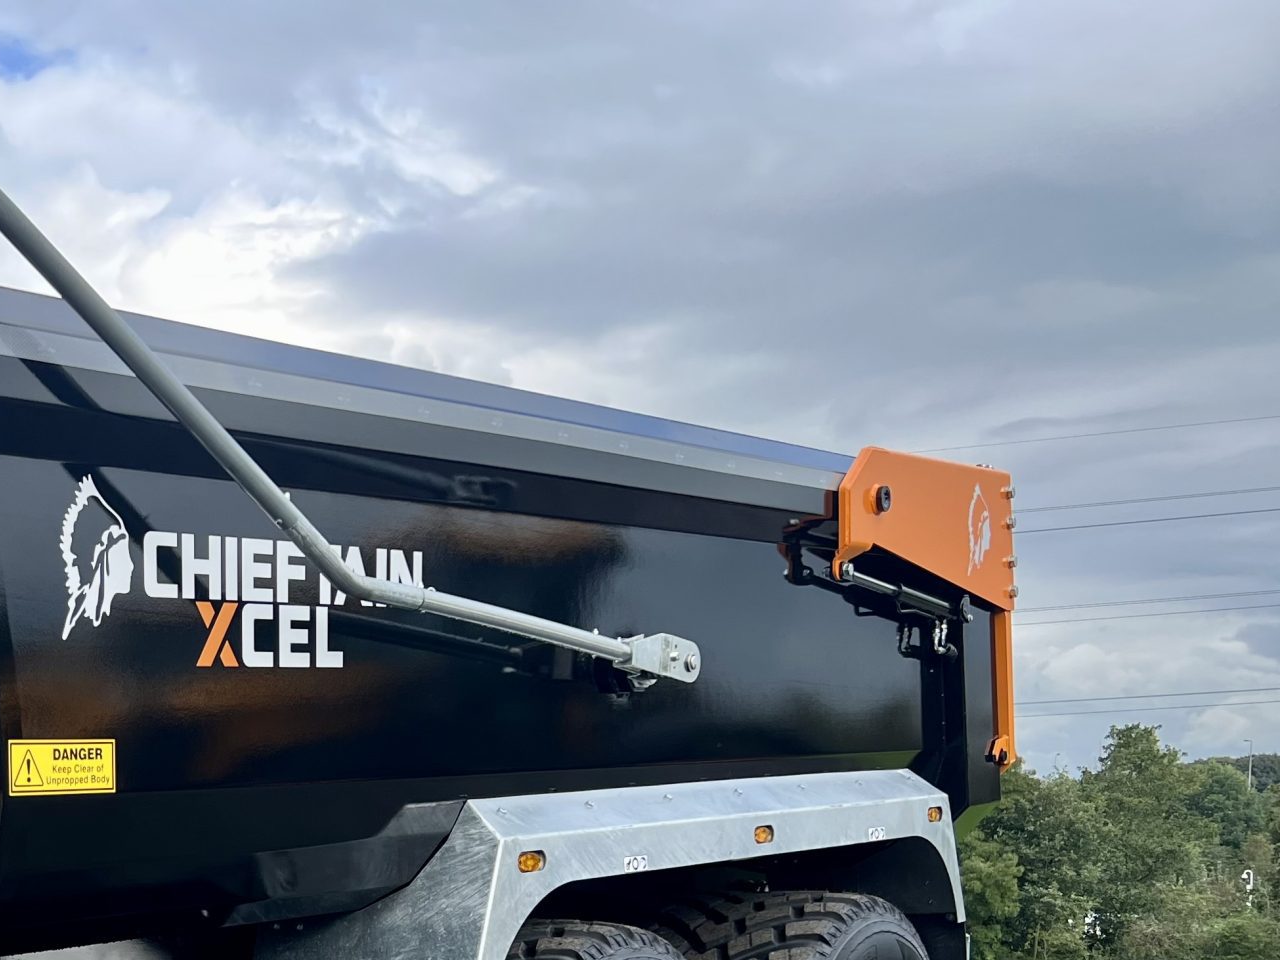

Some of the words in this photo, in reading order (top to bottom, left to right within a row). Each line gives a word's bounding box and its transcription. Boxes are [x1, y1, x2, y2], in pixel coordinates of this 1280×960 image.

[195, 601, 344, 668] XCEL
[52, 747, 104, 761] DANGER
[52, 765, 72, 775] Keep
[74, 764, 94, 773] Clear
[96, 763, 105, 773] of
[46, 775, 89, 786] Unpropped
[90, 774, 110, 785] Body
